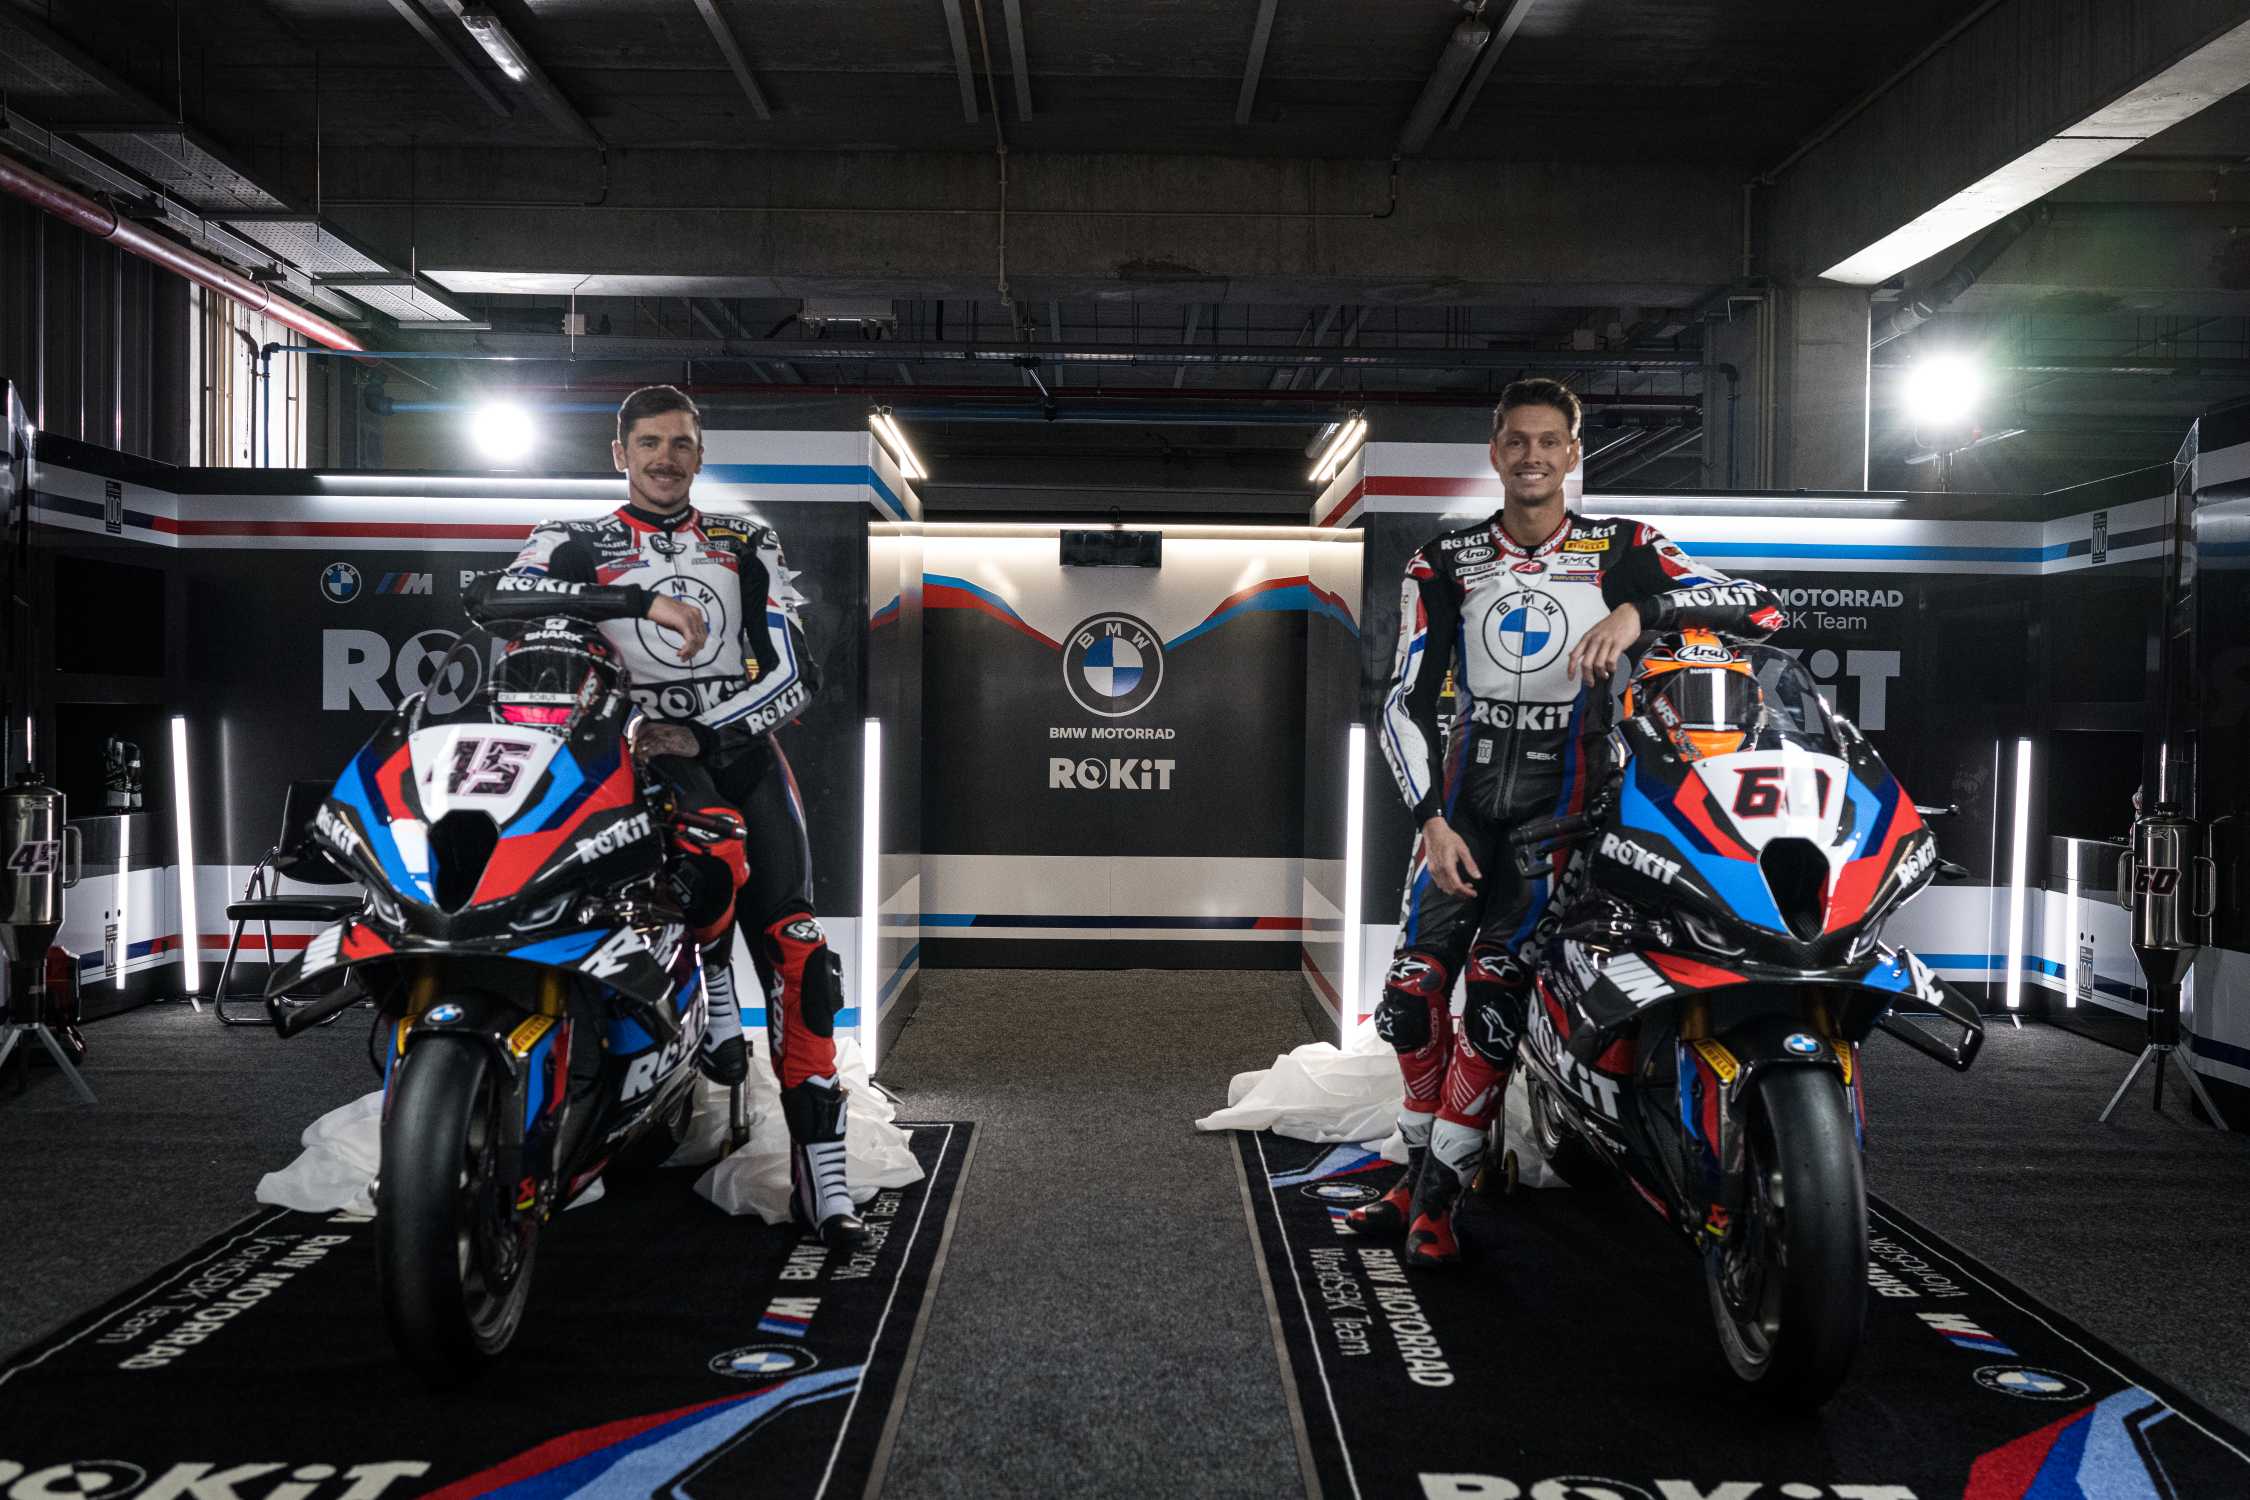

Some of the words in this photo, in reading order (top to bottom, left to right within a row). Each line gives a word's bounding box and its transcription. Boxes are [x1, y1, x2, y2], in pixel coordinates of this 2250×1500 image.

[1440, 532, 1490, 550] ROKiT
[496, 575, 586, 595] ROKiT
[671, 580, 713, 604] MW
[1671, 586, 1758, 607] ROKiT
[1496, 594, 1559, 616] BMW
[1813, 611, 1867, 630] Team
[525, 630, 583, 643] SHARK
[1077, 622, 1151, 650] BMW
[1682, 646, 1725, 659] Arai
[630, 681, 745, 719] ROK
[746, 681, 805, 735] ROKiT
[1471, 700, 1574, 730] ROKiT
[1050, 727, 1087, 739] BMW
[1091, 727, 1176, 740] MOTORRAD
[1049, 757, 1176, 790] ROKiT
[316, 803, 361, 857] ROKiT
[575, 812, 651, 865] ROKiT
[1600, 832, 1682, 885] ROKiT
[1896, 836, 1936, 889] ROKiT
[1358, 1248, 1408, 1284] BMW
[1332, 1316, 1373, 1357] Team
[1373, 1287, 1456, 1388] MOTORRAD
[0, 1459, 432, 1500] OKiT
